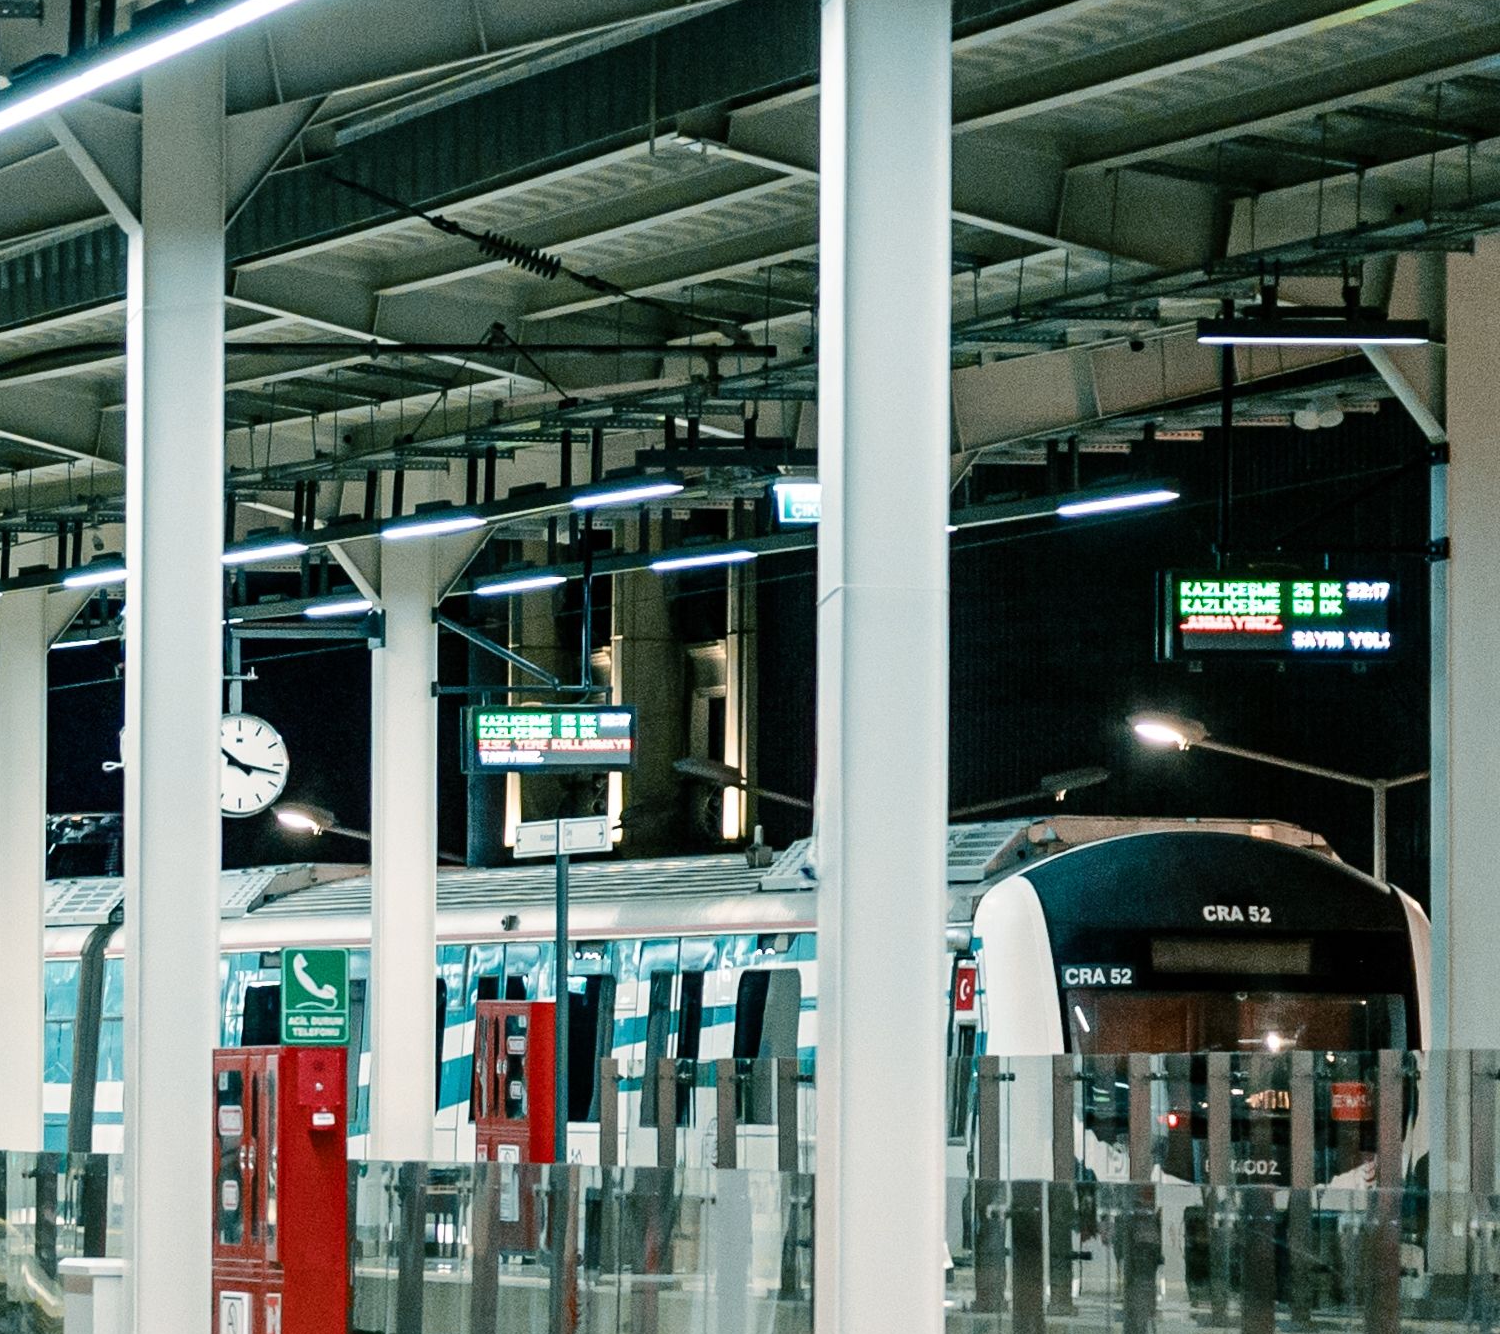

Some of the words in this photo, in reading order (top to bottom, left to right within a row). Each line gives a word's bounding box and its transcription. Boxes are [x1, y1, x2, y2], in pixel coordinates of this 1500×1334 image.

[1319, 582, 1343, 597] DK
[1319, 599, 1343, 614] DK
[1202, 905, 1244, 922] CRA
[1248, 905, 1272, 923] 52
[1064, 968, 1106, 984] CRA
[1110, 968, 1132, 984] 52
